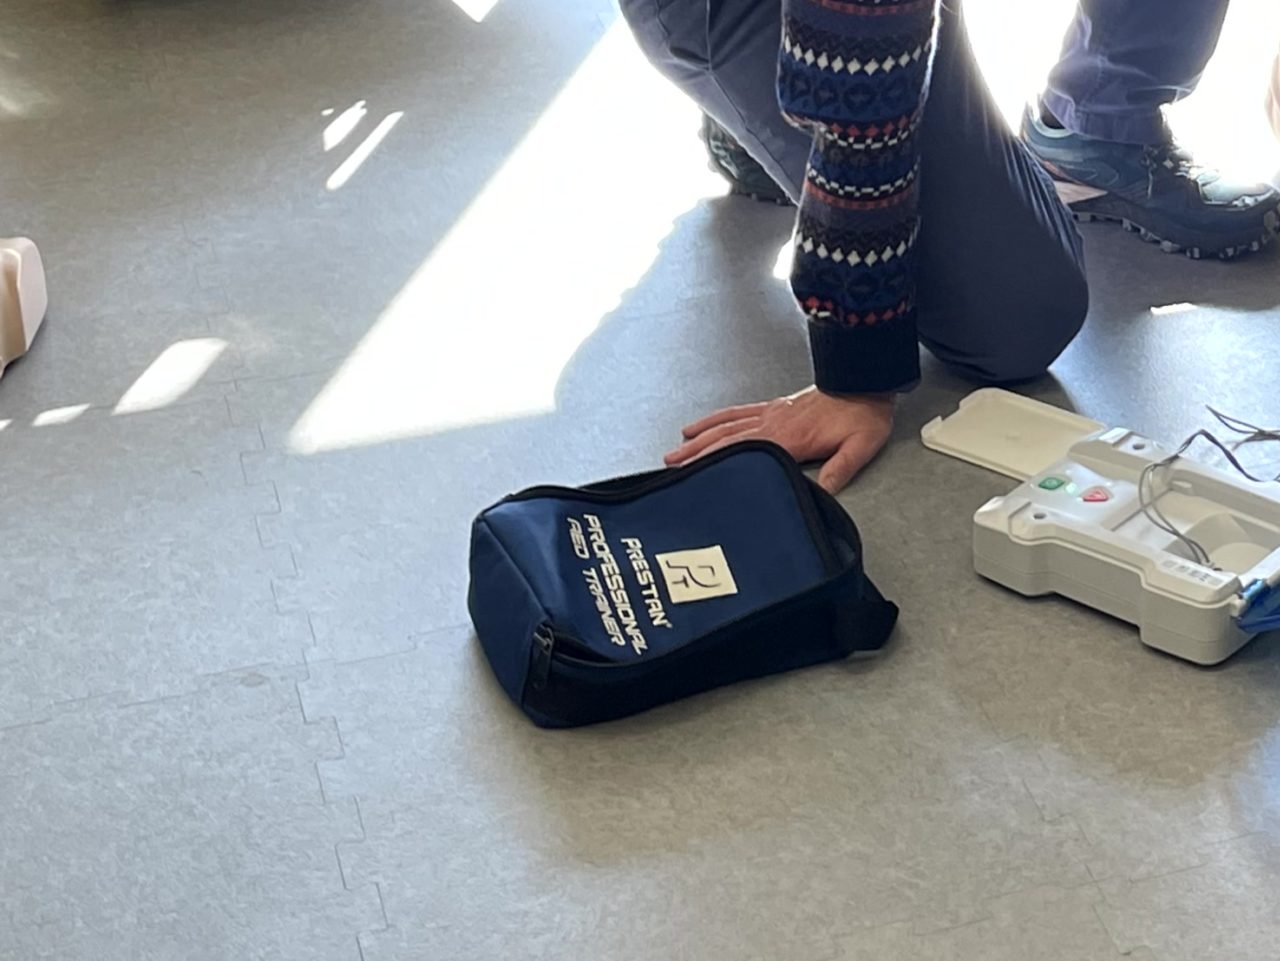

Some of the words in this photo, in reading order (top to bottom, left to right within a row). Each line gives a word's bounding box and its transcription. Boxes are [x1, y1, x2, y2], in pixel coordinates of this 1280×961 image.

[566, 517, 590, 560] AED
[582, 566, 626, 647] TRAINER
[583, 513, 648, 656] PROFESSIONAL
[620, 537, 669, 627] PRESTAN
